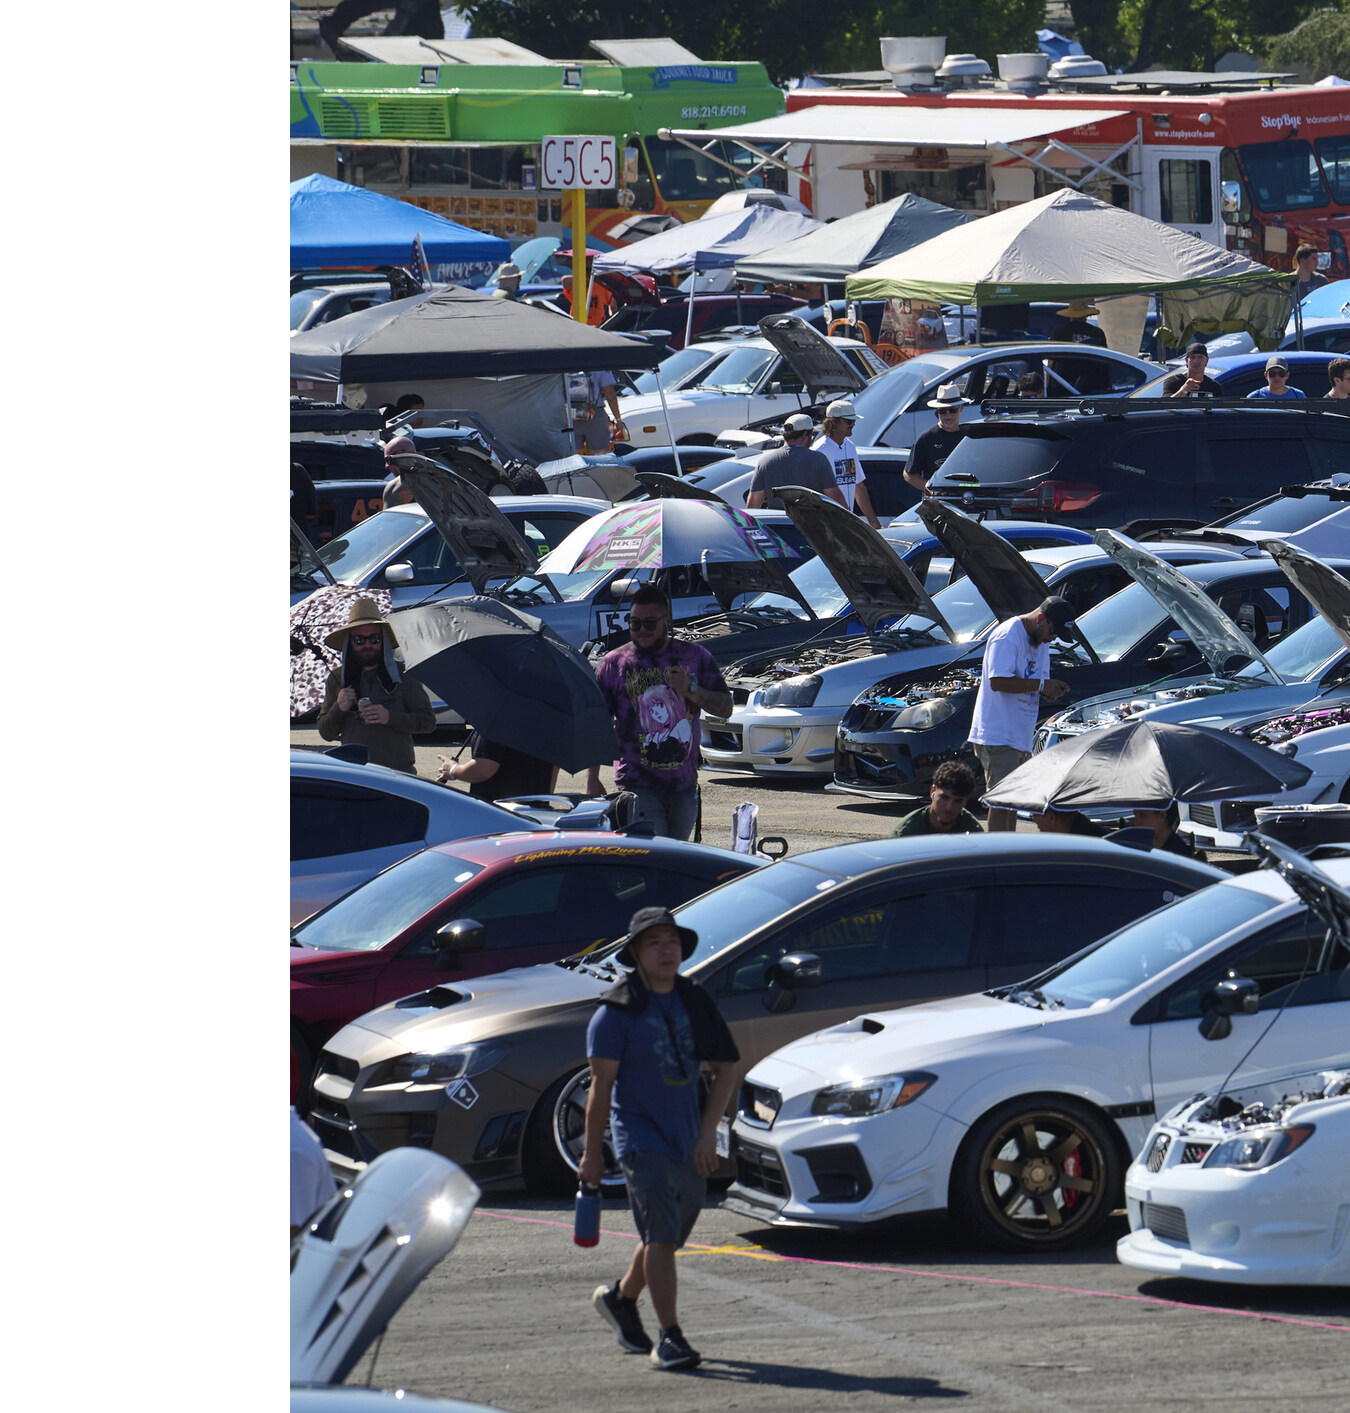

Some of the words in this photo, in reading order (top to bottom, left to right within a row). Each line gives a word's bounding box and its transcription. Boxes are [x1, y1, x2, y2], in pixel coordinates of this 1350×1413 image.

[681, 105, 747, 118] 818.219.6904
[1261, 113, 1302, 130] StopBye
[1305, 116, 1339, 124] Indonesian
[1154, 130, 1216, 140] www.stopbyecafe.com
[544, 140, 576, 186] C-5
[579, 140, 613, 186] C-5
[611, 538, 643, 550] HKS
[514, 848, 577, 863] Lightning
[577, 845, 651, 858] McQueen
